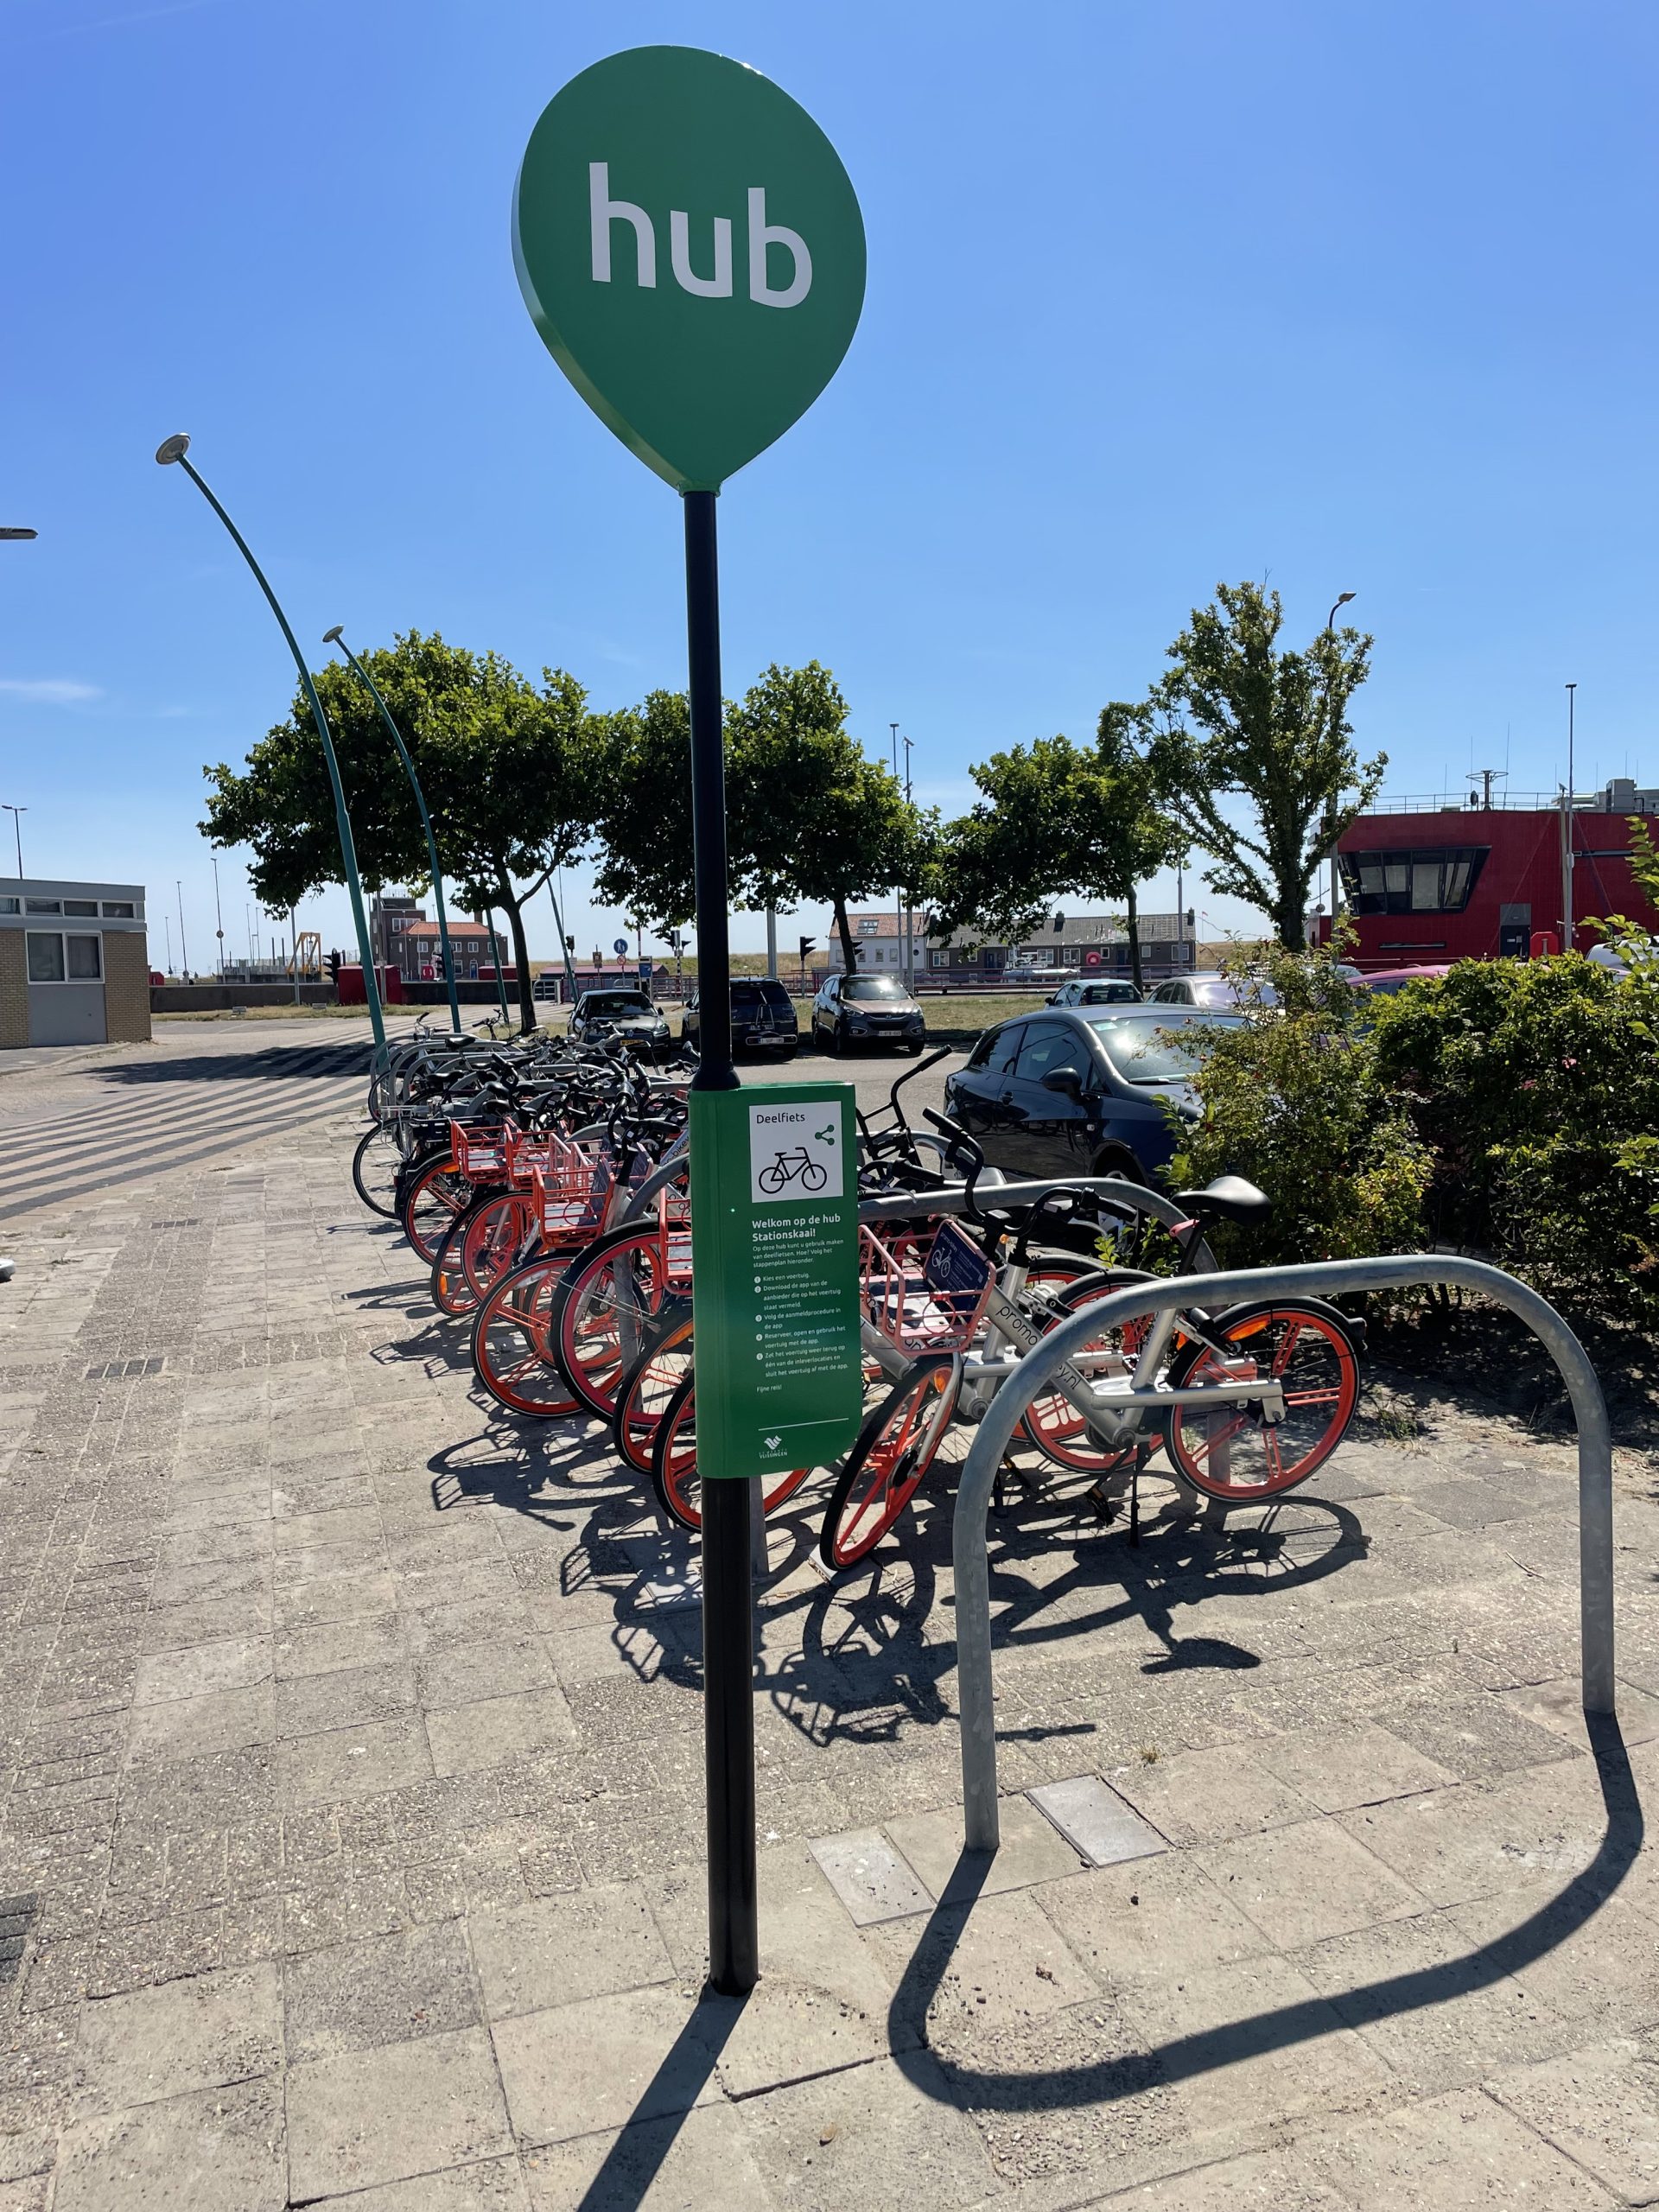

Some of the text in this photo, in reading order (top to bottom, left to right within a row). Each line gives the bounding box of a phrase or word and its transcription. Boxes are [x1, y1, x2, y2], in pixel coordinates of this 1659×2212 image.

[589, 162, 813, 308] hub
[756, 1112, 805, 1124] Deelfiets
[752, 1213, 840, 1229] Welkom op de hub
[752, 1228, 816, 1242] Stationskaai!
[785, 1308, 835, 1318] aanmeldprocedure
[795, 1355, 833, 1364] inleverlocaties
